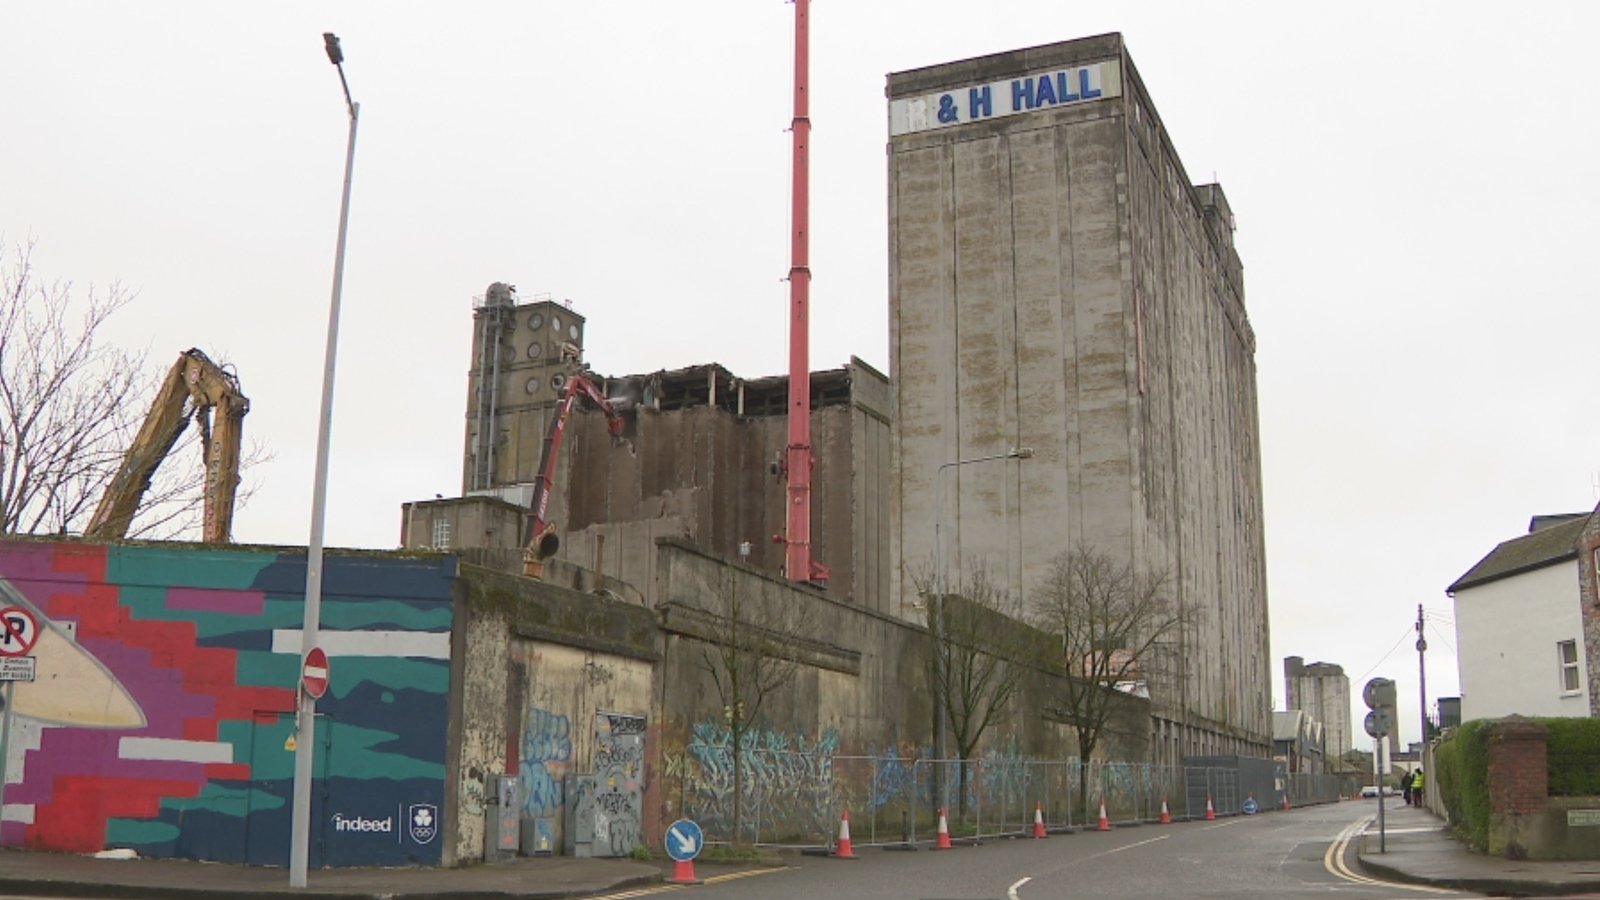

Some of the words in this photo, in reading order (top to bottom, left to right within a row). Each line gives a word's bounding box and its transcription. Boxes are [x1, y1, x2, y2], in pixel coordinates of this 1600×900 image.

[938, 94, 958, 124] &
[969, 85, 992, 119] H
[1011, 69, 1102, 112] HALL
[332, 813, 391, 832] indeed
